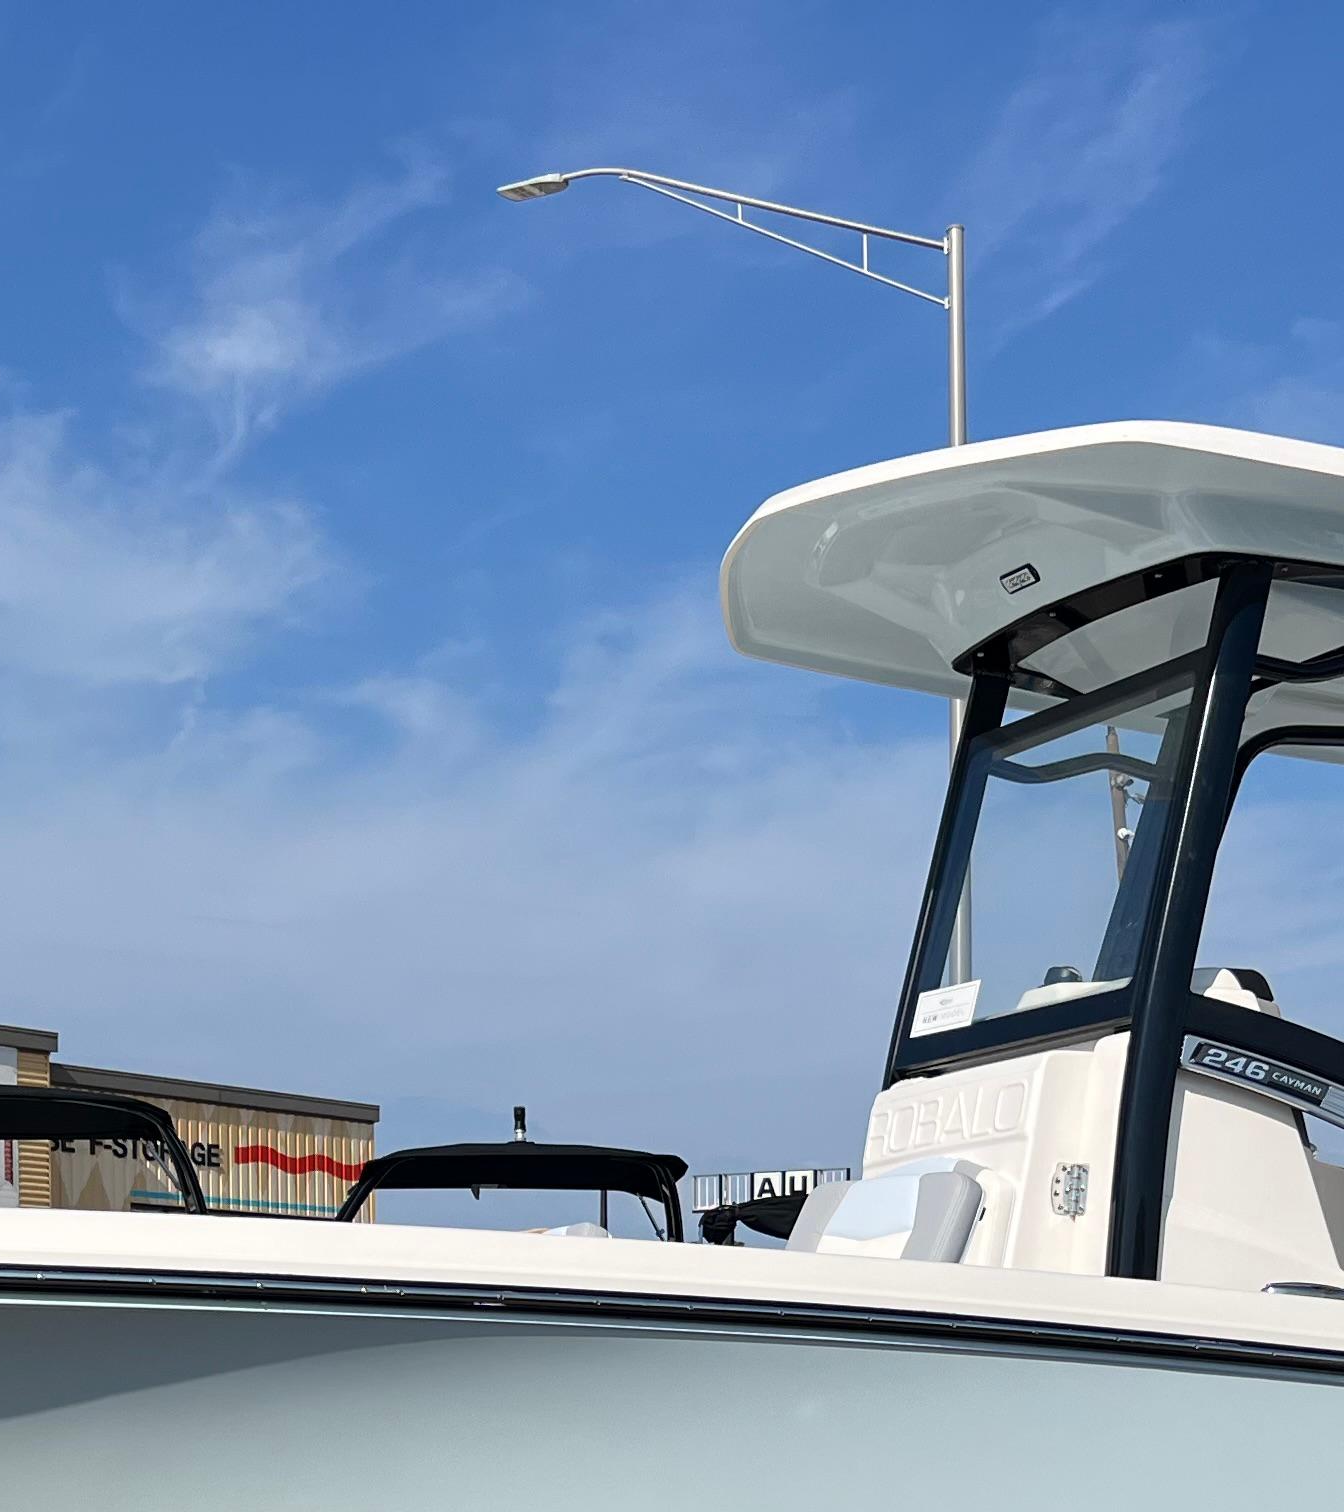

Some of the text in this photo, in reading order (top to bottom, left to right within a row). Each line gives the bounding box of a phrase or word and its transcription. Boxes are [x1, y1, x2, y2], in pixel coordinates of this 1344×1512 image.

[1203, 1048, 1322, 1096] 246 CAYMAN
[866, 1080, 1029, 1158] ROBALO
